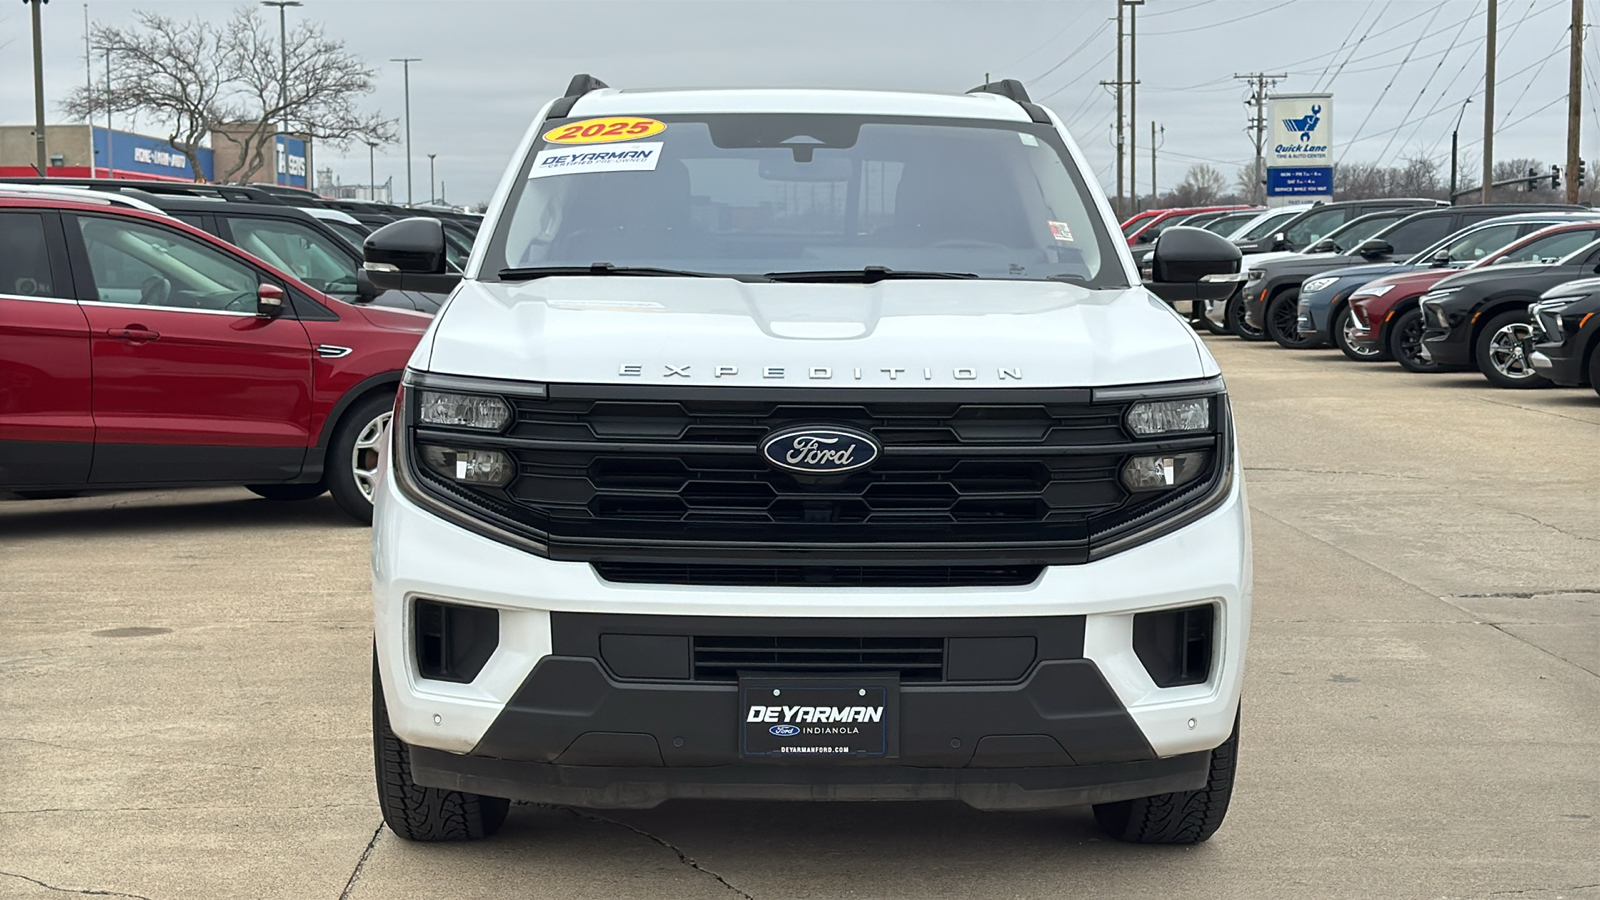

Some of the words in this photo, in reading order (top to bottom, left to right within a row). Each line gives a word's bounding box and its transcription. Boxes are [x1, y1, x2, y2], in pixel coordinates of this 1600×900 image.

[555, 121, 654, 141] 2025
[1275, 144, 1302, 153] Quick
[1302, 144, 1327, 152] Lane
[541, 150, 653, 166] DEYARMAN
[548, 160, 593, 168] CERTIFIED
[618, 363, 1023, 380] EXPEDITION
[786, 435, 854, 466] Ford
[747, 705, 884, 723] DEYARMAN
